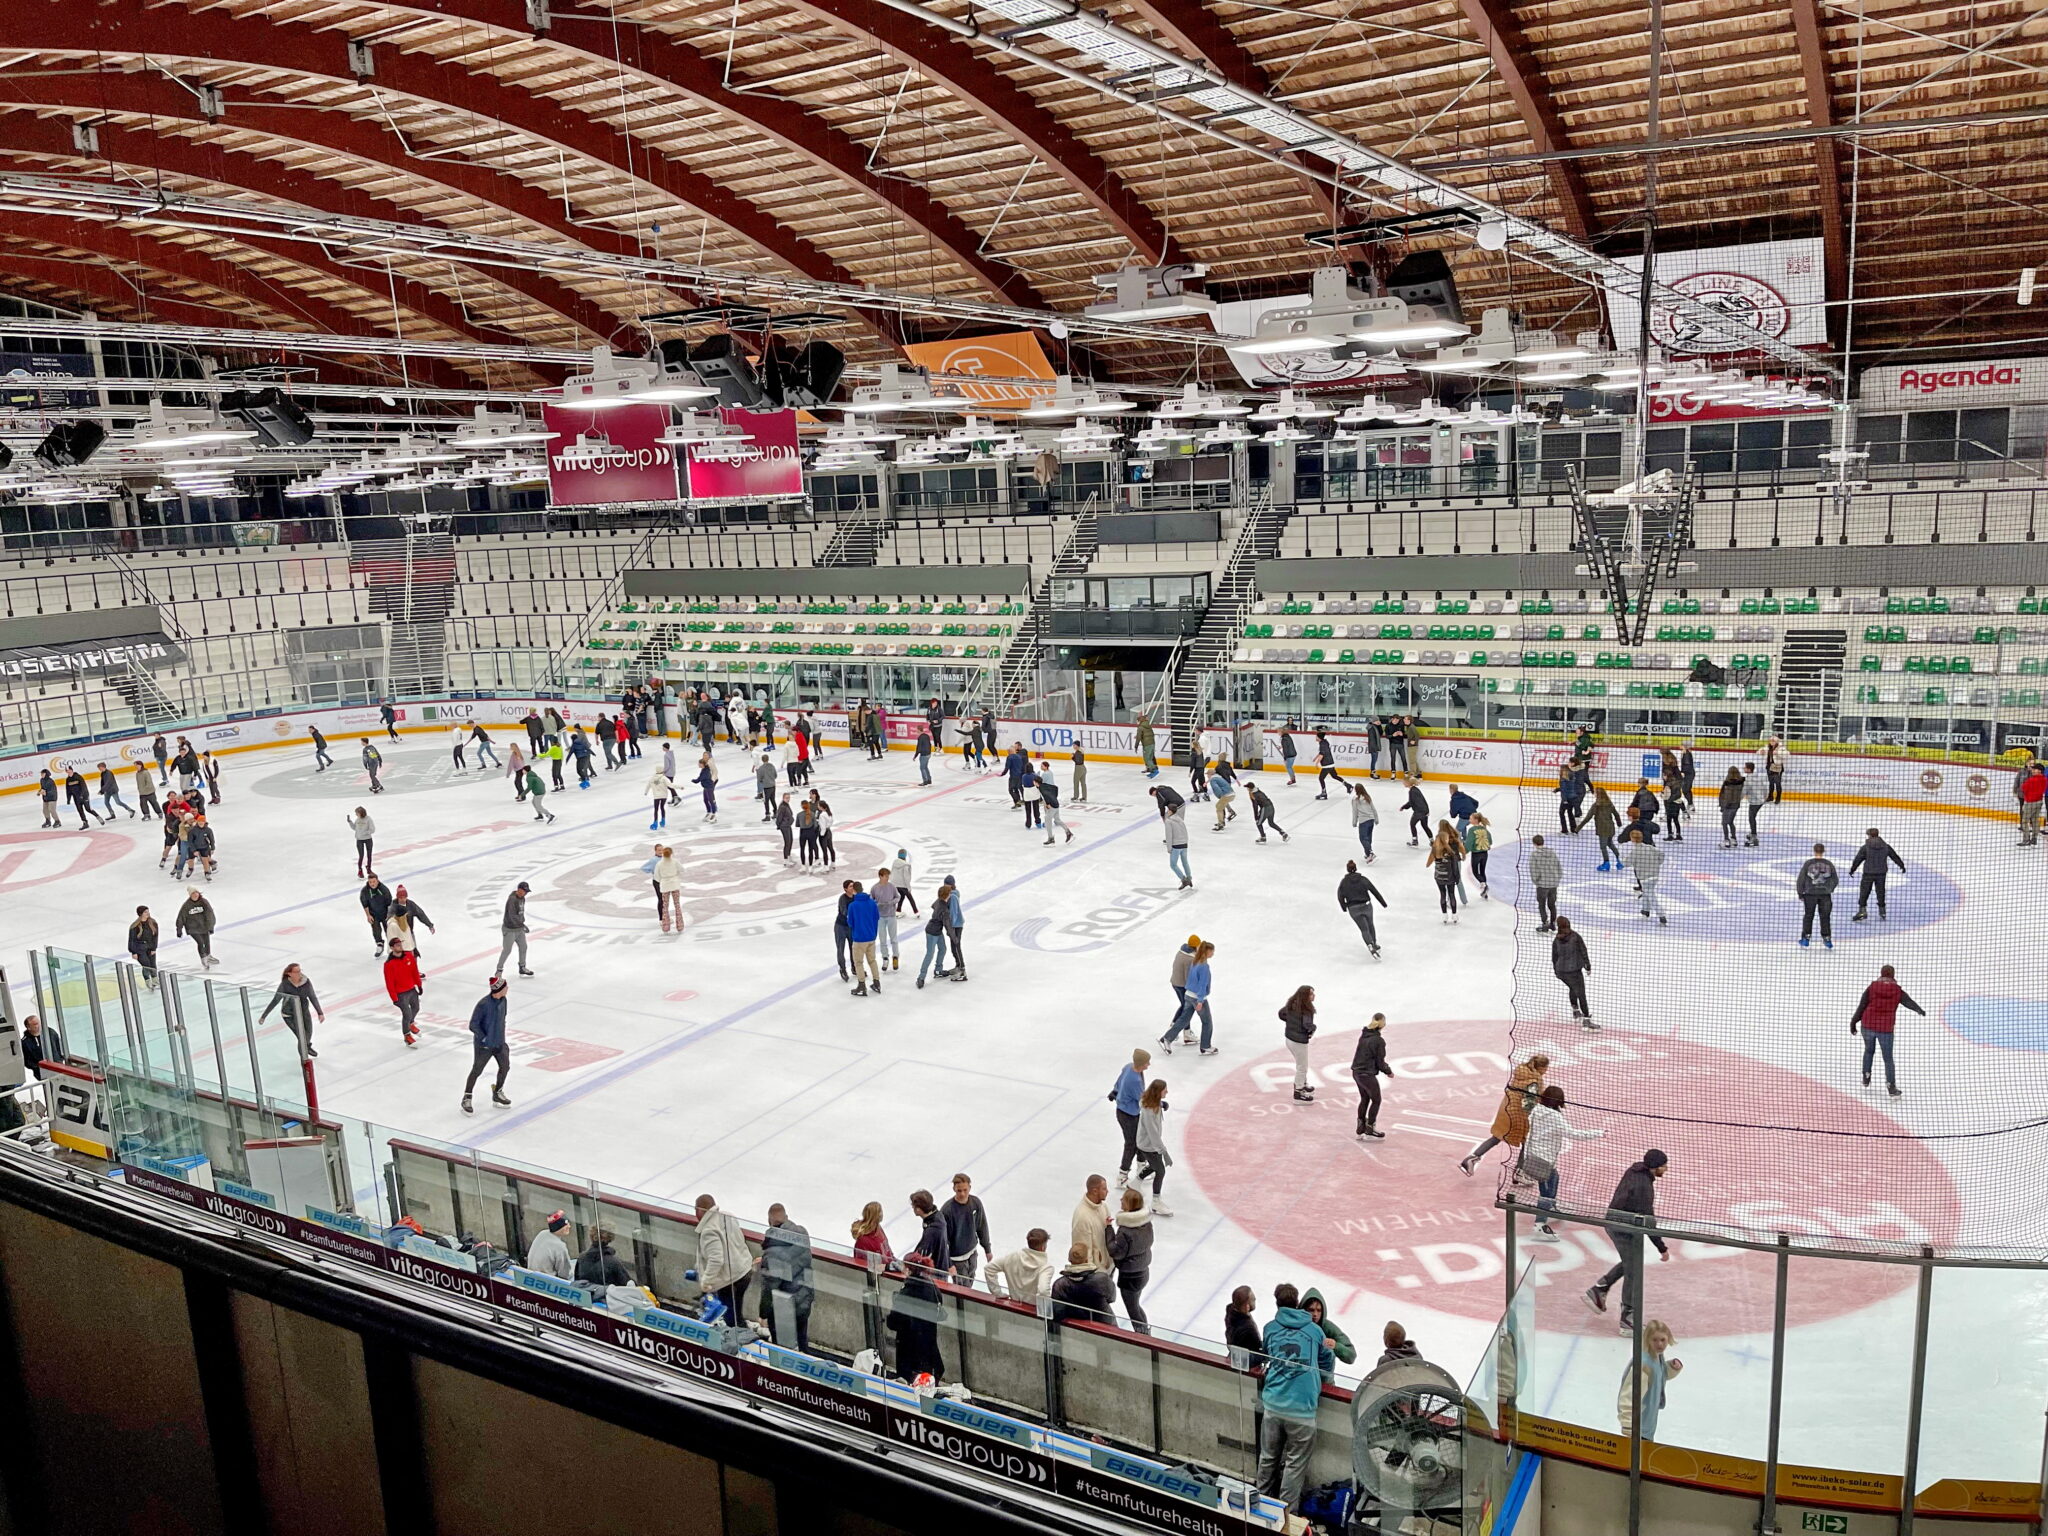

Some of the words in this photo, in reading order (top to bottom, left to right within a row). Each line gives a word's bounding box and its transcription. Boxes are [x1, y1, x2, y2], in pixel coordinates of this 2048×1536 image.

[1900, 365, 2022, 393] Agenda:
[803, 670, 832, 678] SCHWDKE
[932, 673, 964, 682] SCWADKE
[440, 704, 473, 717] MCP
[500, 704, 529, 716] komr
[130, 746, 152, 756] ISOM
[1031, 727, 1073, 748] OVB
[1422, 749, 1453, 760] AUTO
[1455, 748, 1488, 761] EDER
[131, 1173, 195, 1203] #teamfuturehealth
[224, 1183, 269, 1204] BAUER
[206, 1196, 276, 1233] vitagroup
[313, 1209, 363, 1233] BAUER
[300, 1227, 376, 1263] #teamfuturehealth
[389, 1254, 474, 1299] vitagroup
[523, 1275, 583, 1302] BAUER
[505, 1293, 598, 1334] #teamfuturehealth
[643, 1312, 710, 1343] BAUER
[615, 1327, 717, 1376] vitagroup
[779, 1355, 856, 1389] BAUER
[756, 1375, 872, 1424] #teamfuturehealth
[932, 1402, 1019, 1439] BAUER
[895, 1417, 1025, 1477] vitagroup
[1105, 1457, 1202, 1498] BAUER
[1792, 1473, 1885, 1489] www.ibeko-solar.de
[1075, 1478, 1225, 1536] #teamfuturehealth
